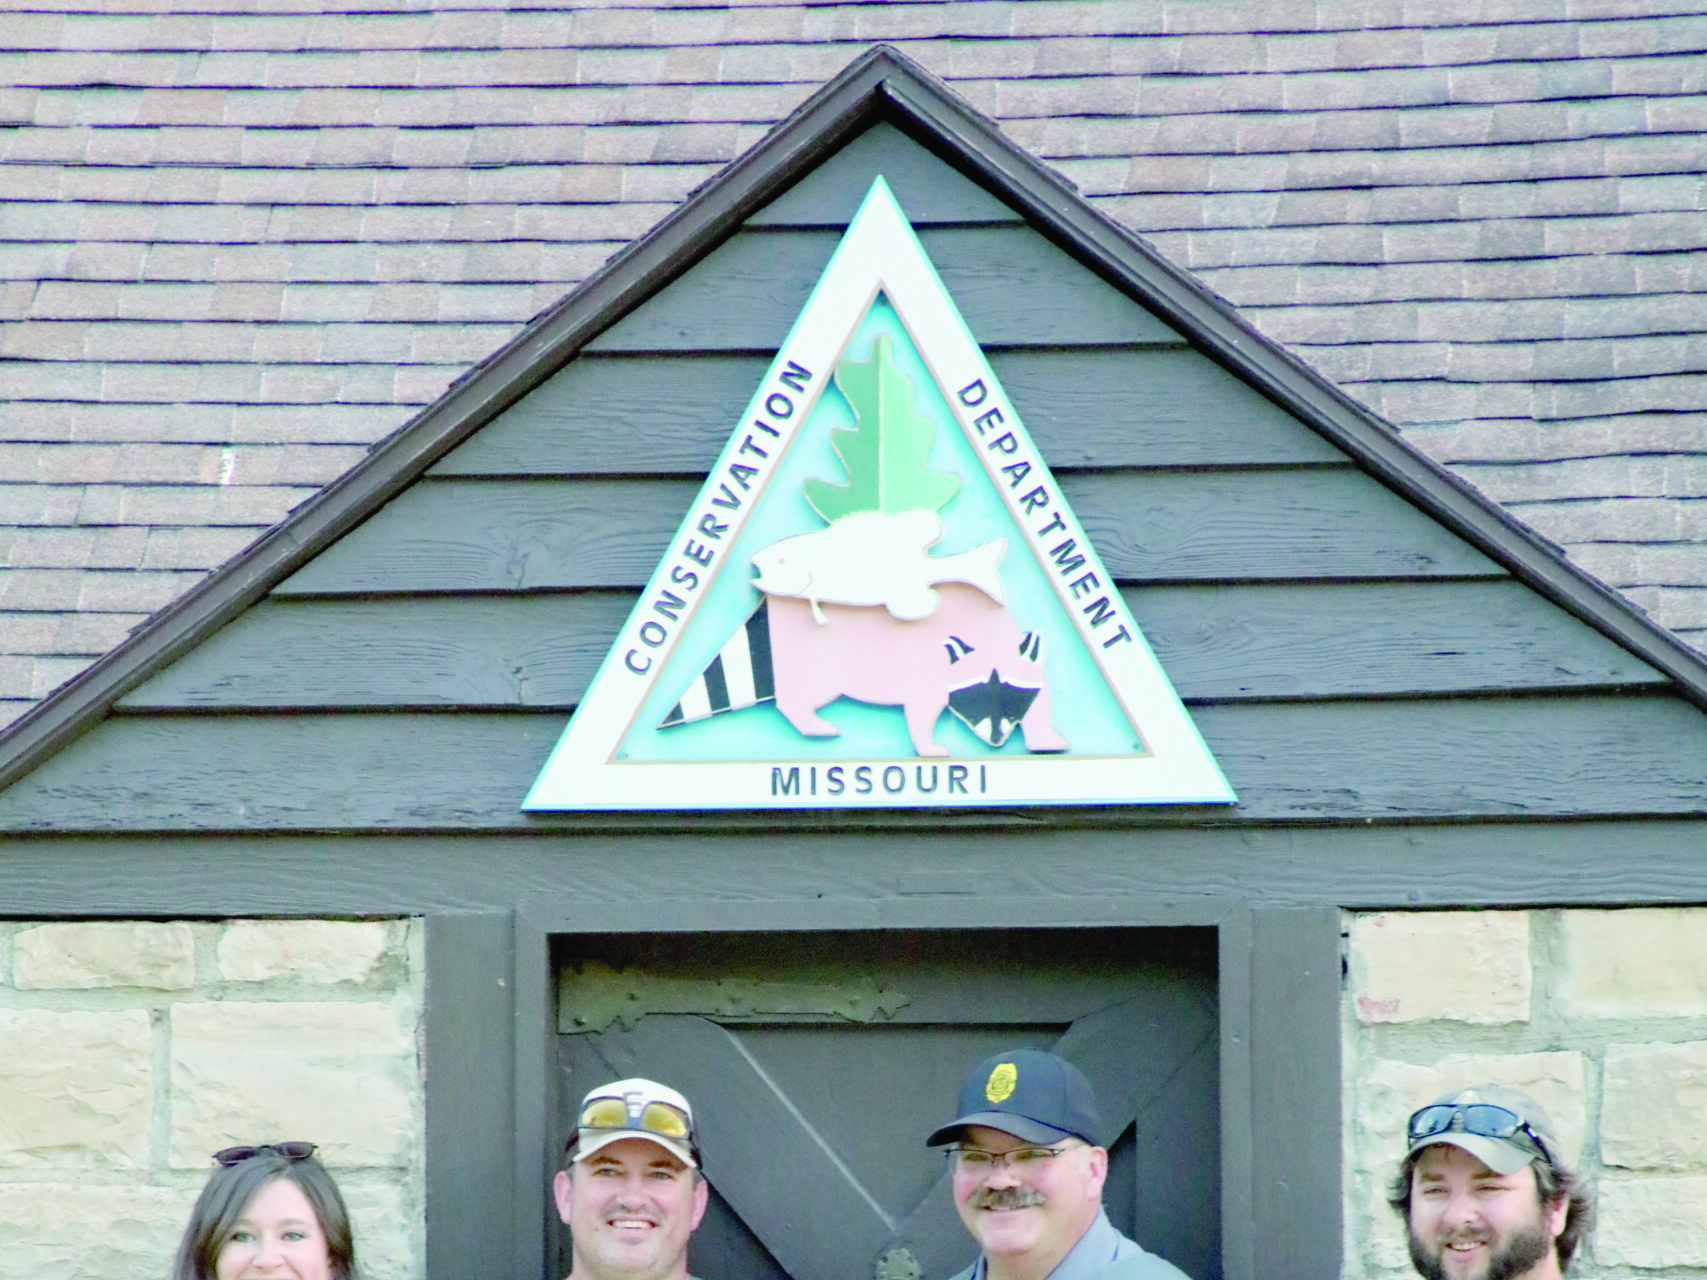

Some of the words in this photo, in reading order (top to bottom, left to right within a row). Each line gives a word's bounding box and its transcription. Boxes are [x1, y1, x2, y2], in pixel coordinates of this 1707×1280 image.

[624, 360, 814, 677] CONSERVATION
[957, 378, 1132, 651] DEPARTMENT
[771, 764, 988, 797] MISSOURI
